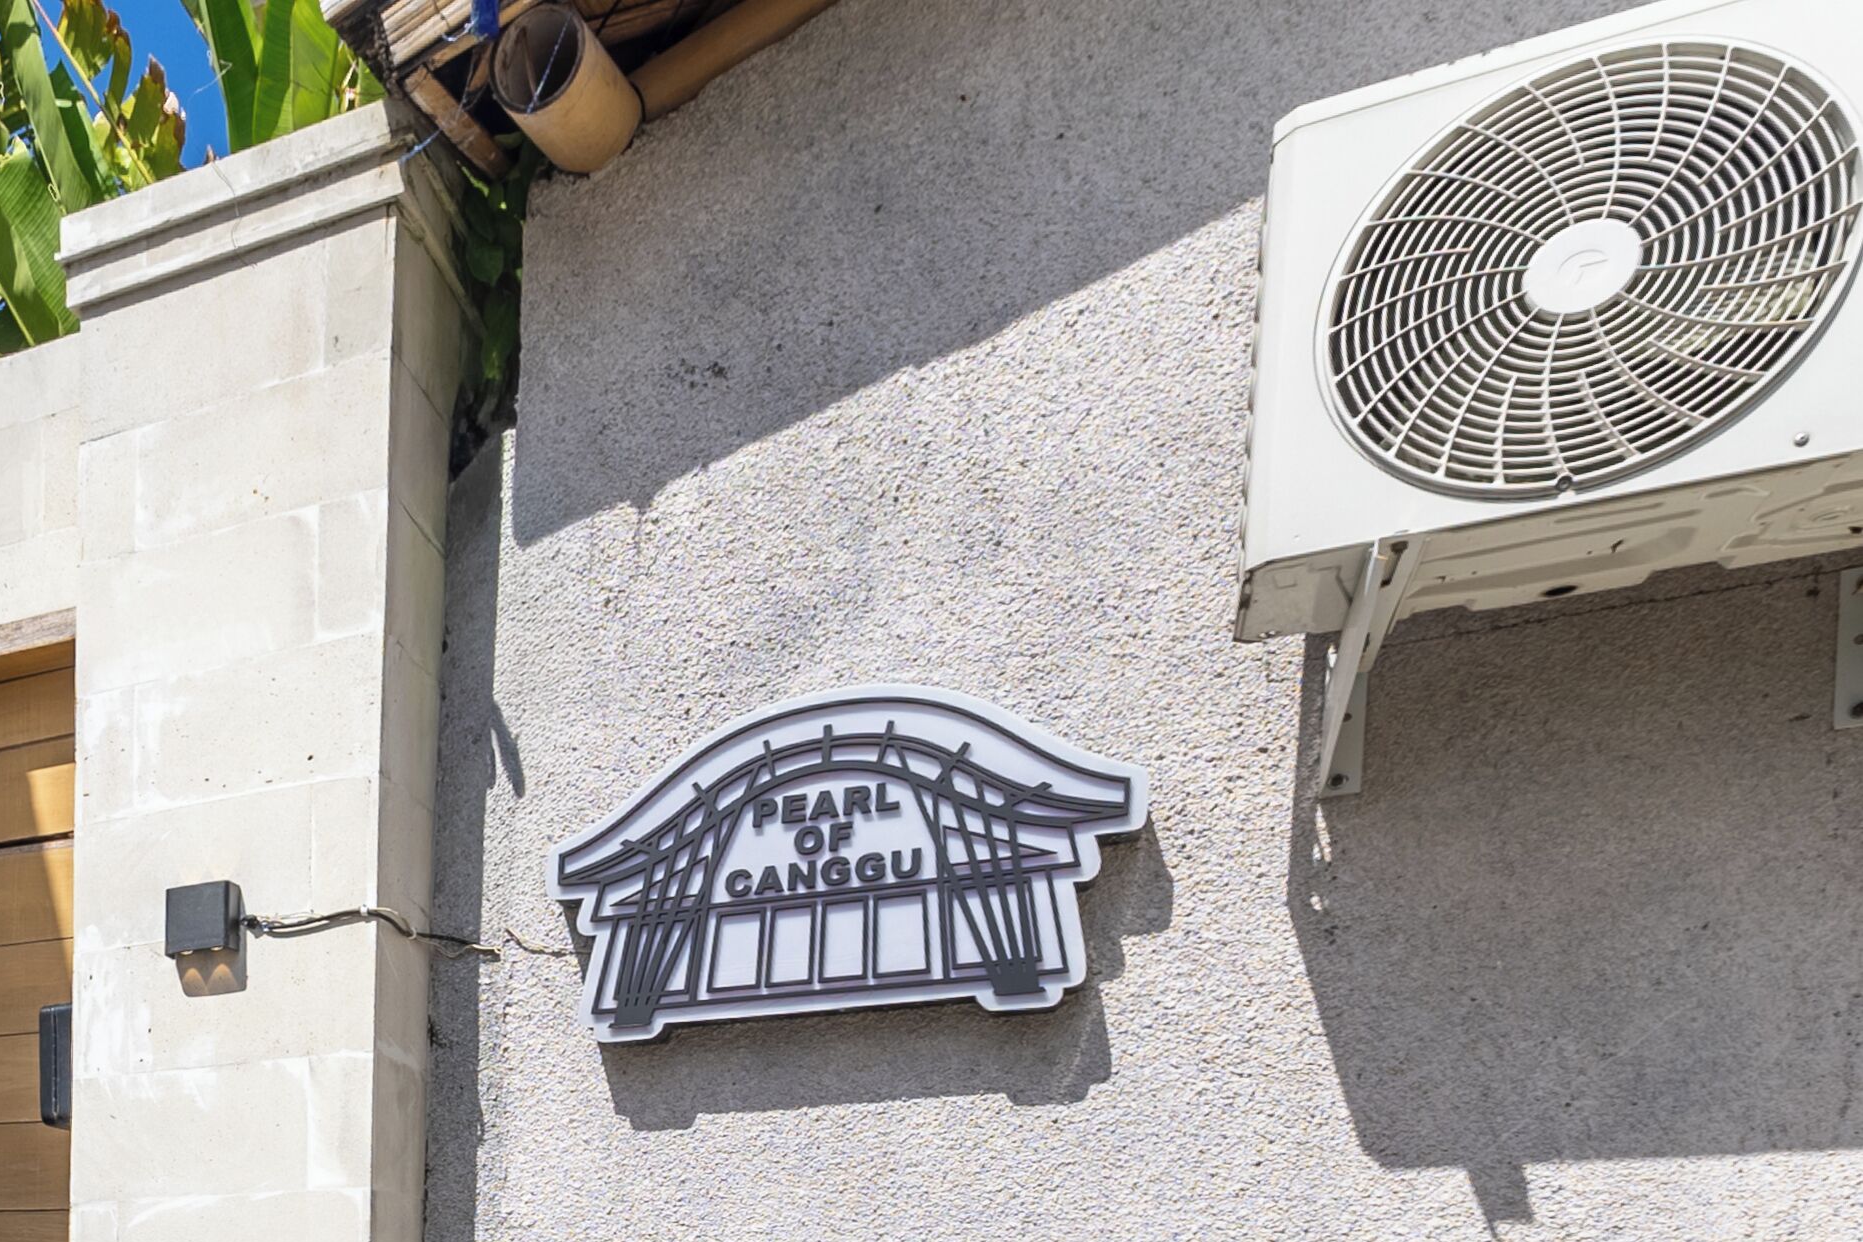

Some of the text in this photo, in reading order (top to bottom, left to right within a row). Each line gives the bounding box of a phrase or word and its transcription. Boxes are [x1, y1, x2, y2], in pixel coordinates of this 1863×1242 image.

[752, 782, 900, 828] PEARL
[794, 821, 853, 855] OF
[725, 848, 922, 898] CANGGU
